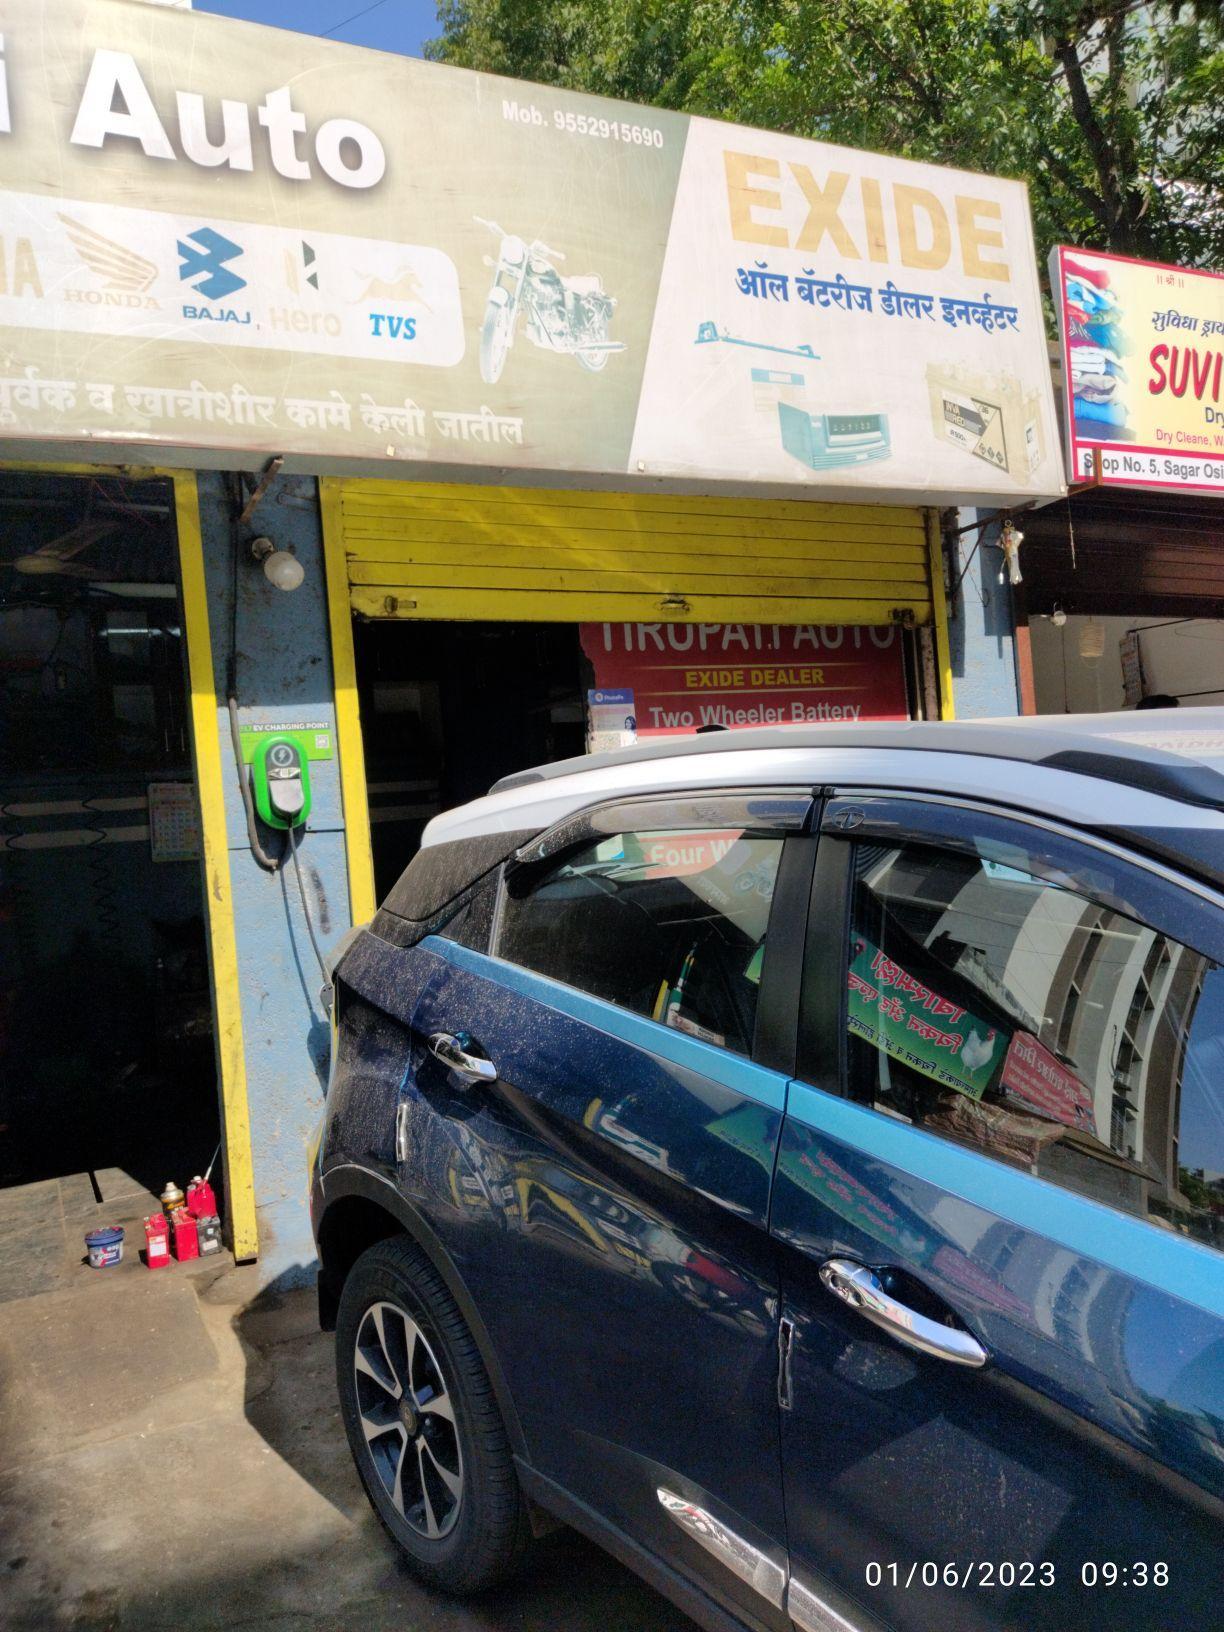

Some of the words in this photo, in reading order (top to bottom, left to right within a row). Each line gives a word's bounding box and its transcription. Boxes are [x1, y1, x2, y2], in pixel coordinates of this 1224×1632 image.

[70, 48, 386, 189] Auto
[502, 100, 548, 127] Mob.
[553, 110, 664, 148] 9552915690
[723, 150, 1011, 282] EXIDE
[63, 289, 161, 310] HONDA
[735, 260, 789, 302] ऑल
[795, 266, 872, 312] बॅटरीज
[879, 280, 936, 321] डीलर
[182, 305, 251, 324] BAJAJ
[268, 306, 342, 337] Hero
[369, 313, 416, 340] TVS
[1152, 309, 1199, 332] सुविधा
[86, 383, 115, 414] व
[284, 390, 352, 432] कामे
[360, 392, 426, 437] केली
[432, 405, 523, 444] जातील
[1156, 428, 1173, 444] Dry
[1083, 453, 1119, 474] Sop
[1123, 456, 1145, 473] No.
[1149, 459, 1160, 476] 5,
[1164, 460, 1200, 480] Sagar
[685, 670, 745, 688] EXIDE
[751, 669, 825, 685] DEALER
[264, 723, 305, 731] CHARGING
[306, 722, 329, 730] POINT
[649, 707, 694, 728] Two
[700, 703, 785, 725] Wheeler
[791, 701, 861, 723] Battery
[651, 844, 705, 866] Four
